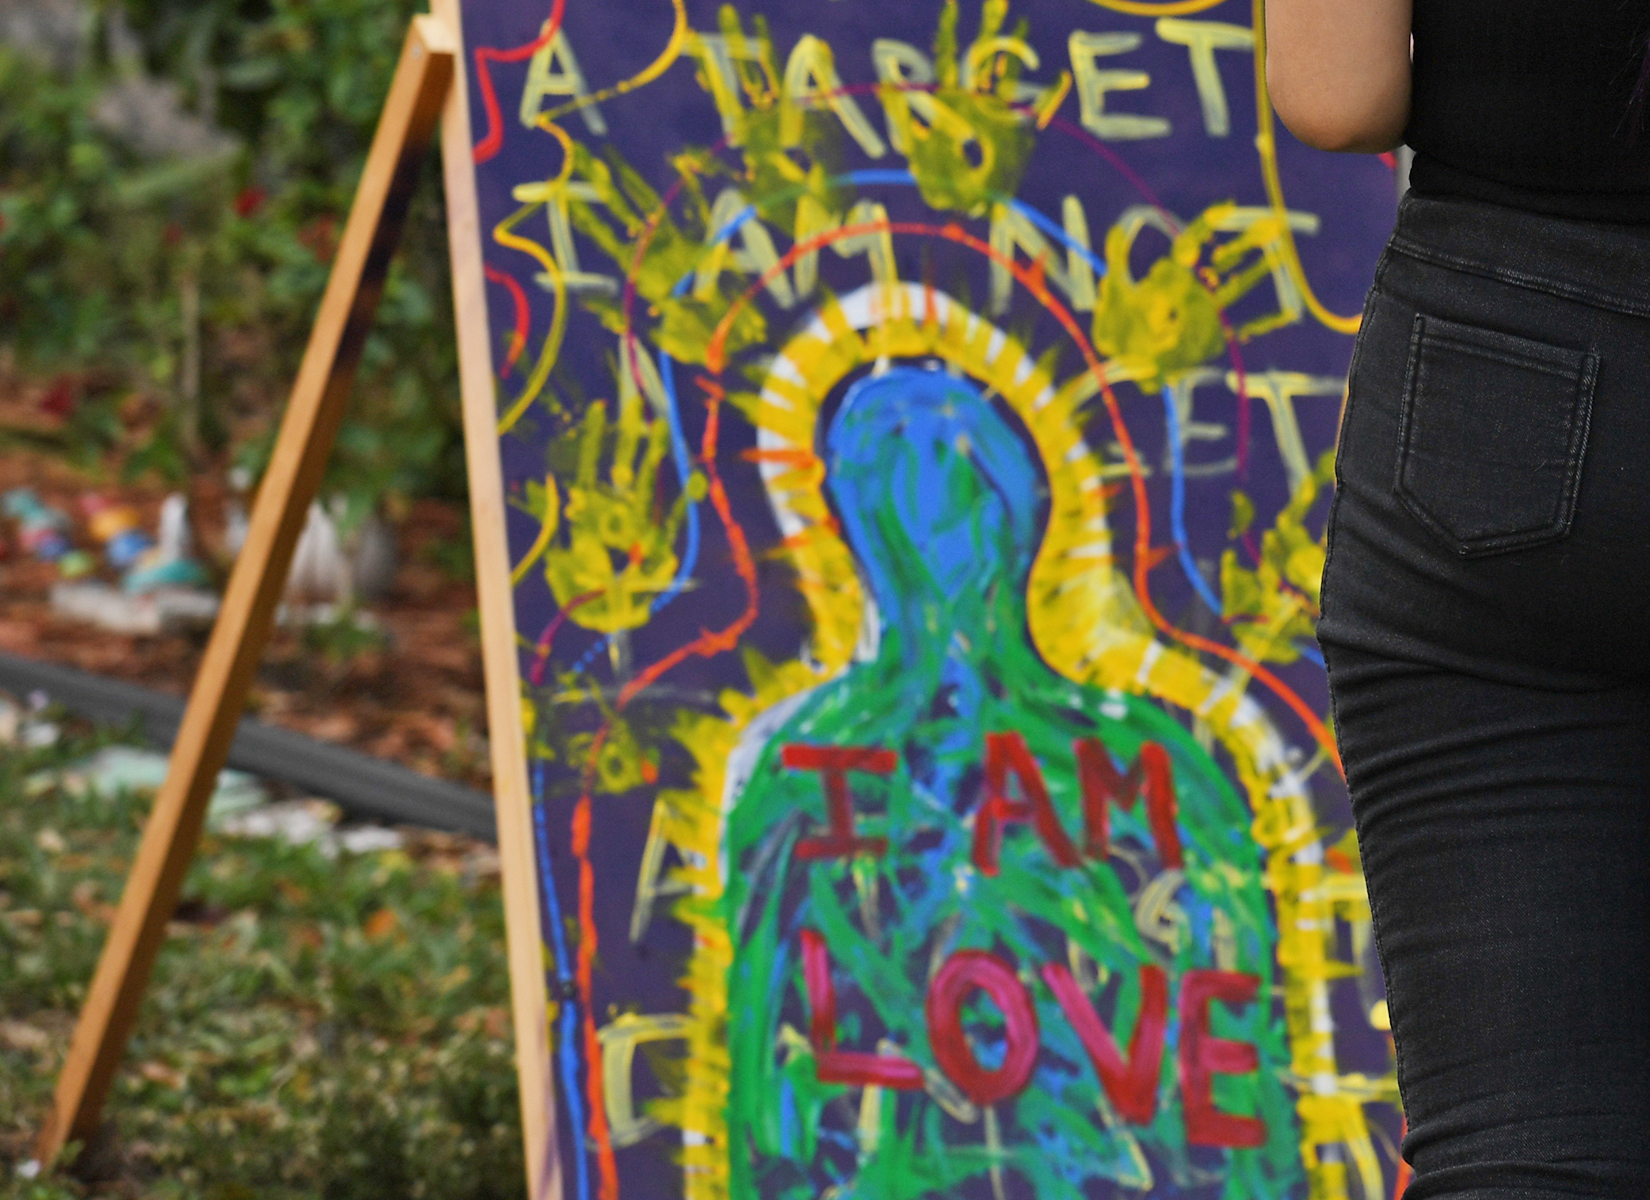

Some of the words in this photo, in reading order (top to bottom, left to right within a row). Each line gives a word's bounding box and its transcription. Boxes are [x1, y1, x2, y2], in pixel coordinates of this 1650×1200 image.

[519, 17, 607, 135] A
[782, 742, 898, 860] I
[971, 730, 1184, 876] AM
[798, 928, 1267, 1149] LOVE
